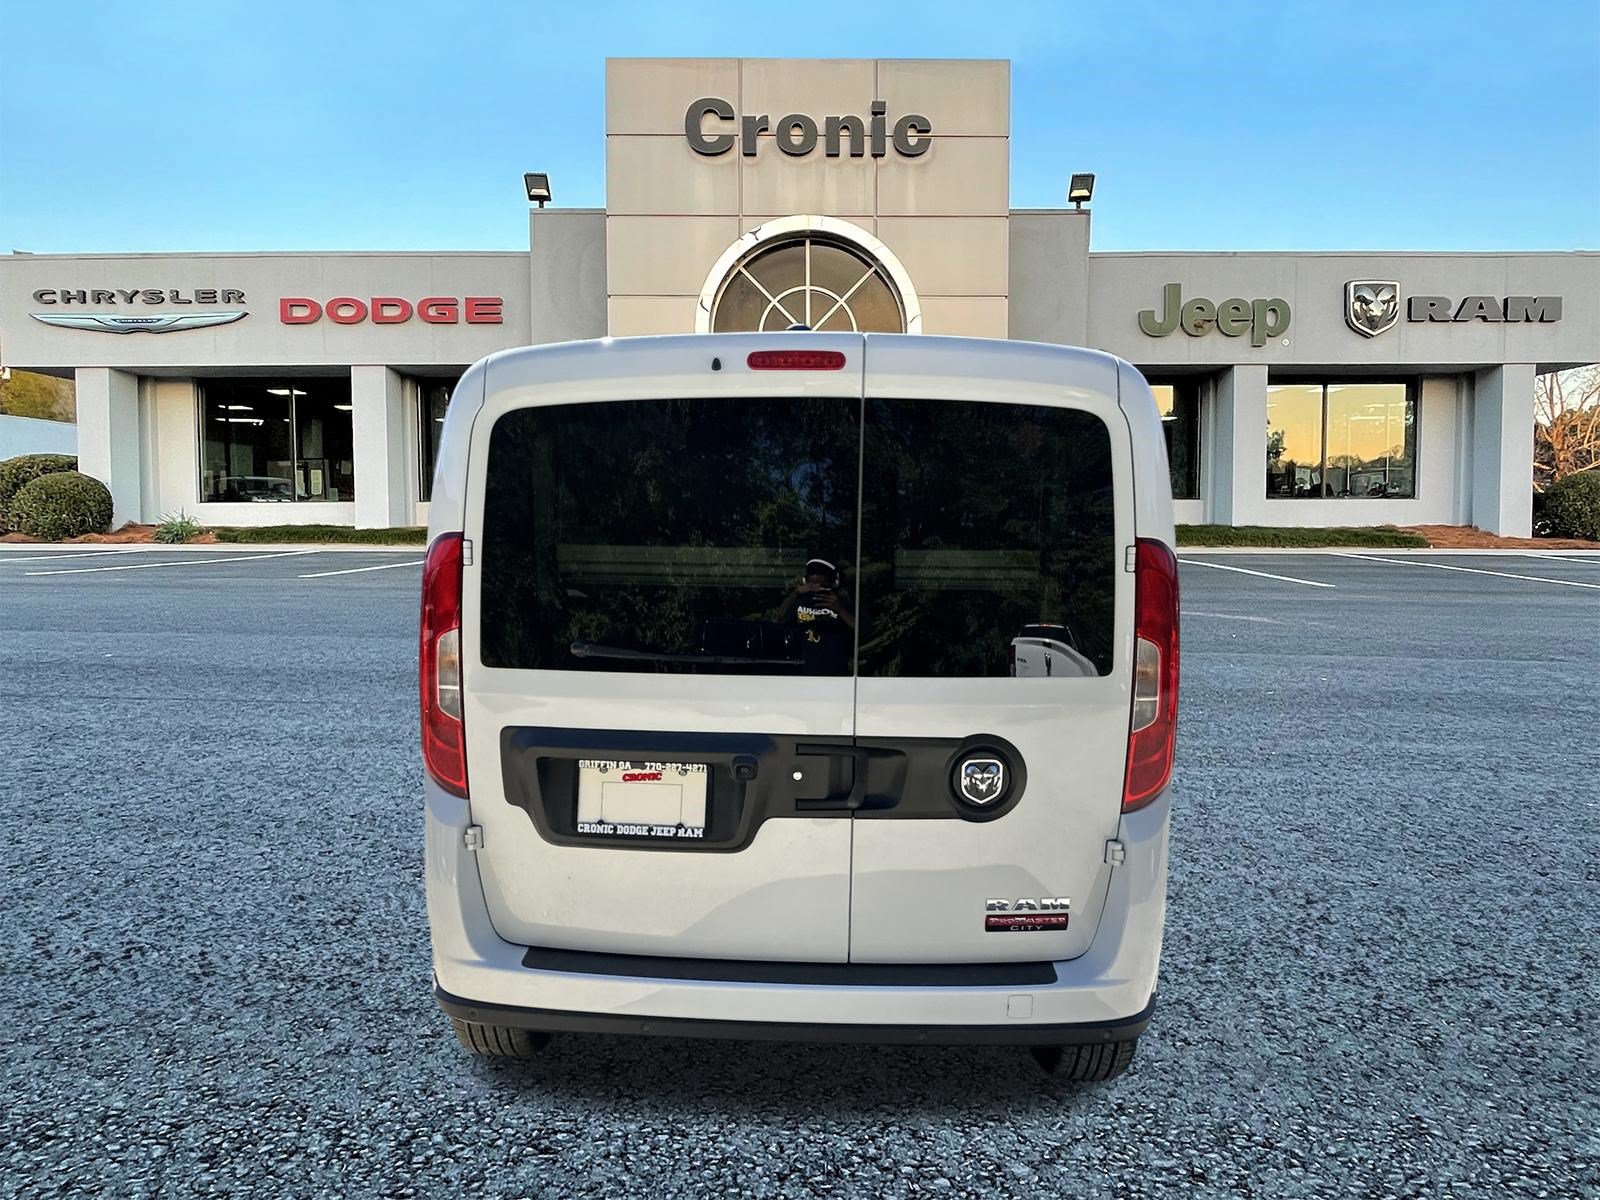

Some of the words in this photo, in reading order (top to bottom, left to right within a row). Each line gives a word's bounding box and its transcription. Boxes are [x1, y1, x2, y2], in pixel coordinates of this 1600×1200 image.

[685, 97, 932, 158] Cronic
[32, 288, 247, 306] CHRYSLER
[280, 296, 504, 325] DODGE
[1138, 282, 1292, 347] Jeep
[1407, 296, 1563, 323] RAM
[578, 759, 617, 769] GRIFFIN
[622, 773, 663, 782] CRONIC
[577, 823, 614, 834] CRONIC
[616, 824, 648, 835] DODGE
[650, 825, 677, 836] JEEP
[677, 827, 704, 838] RAM
[986, 897, 1071, 911] RAM
